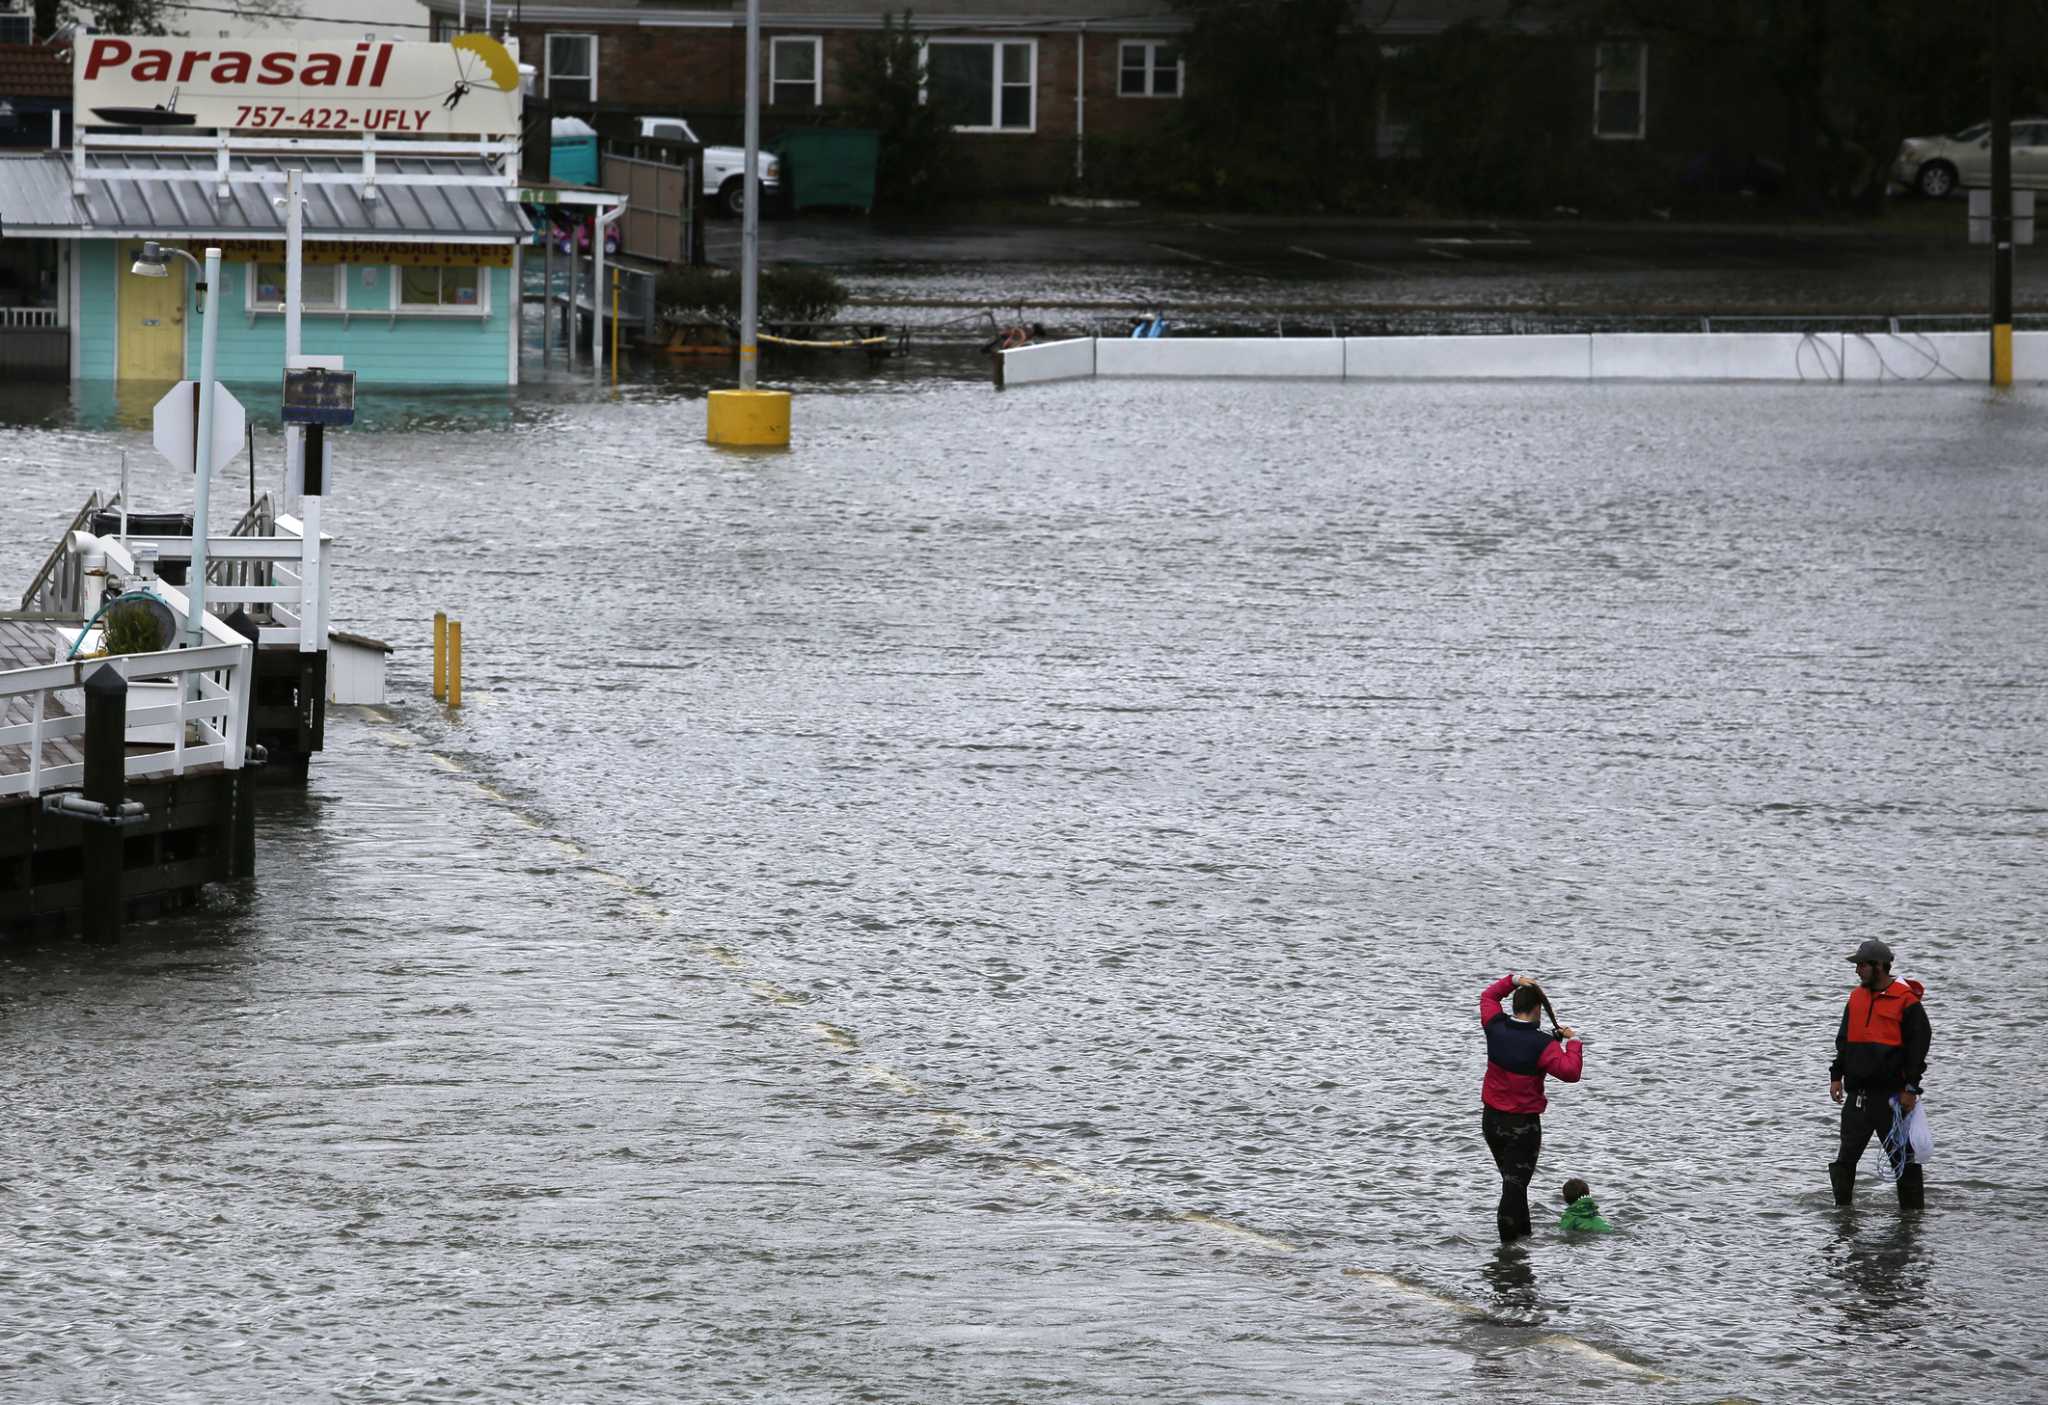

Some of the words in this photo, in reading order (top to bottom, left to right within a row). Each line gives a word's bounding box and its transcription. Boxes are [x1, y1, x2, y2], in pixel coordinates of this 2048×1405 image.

[84, 39, 394, 87] Parasail
[235, 105, 431, 131] 757-422-UFLY
[353, 241, 437, 255] PARASAIL
[445, 243, 512, 257] TICKETS
